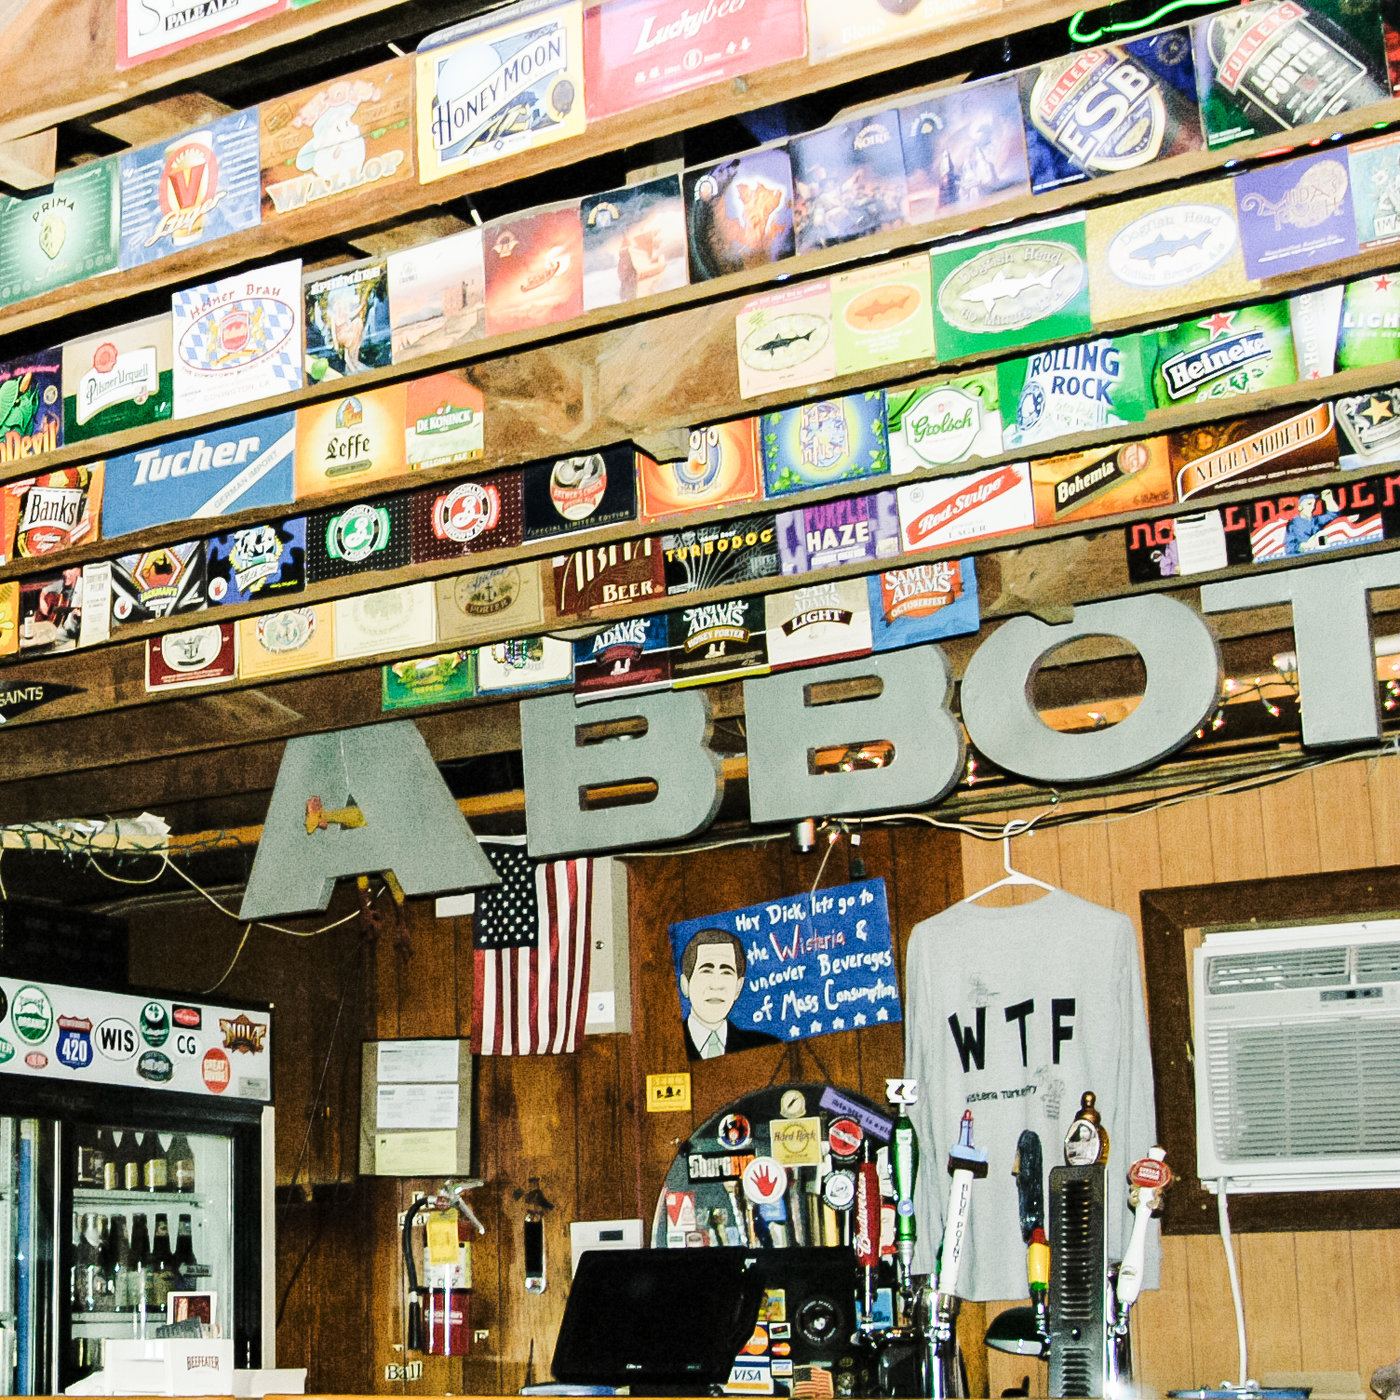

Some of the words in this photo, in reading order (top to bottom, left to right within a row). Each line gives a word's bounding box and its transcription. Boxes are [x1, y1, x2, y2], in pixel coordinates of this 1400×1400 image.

[1251, 31, 1311, 90] LONDON
[1265, 42, 1328, 105] PORTER
[431, 76, 500, 145] HONEY
[504, 38, 563, 92] MOON
[1059, 62, 1151, 161] ESB
[266, 150, 405, 214] WALLOP
[32, 196, 76, 223] PRIMA
[1030, 343, 1120, 379] ROLLING
[1051, 376, 1114, 405] ROCK
[911, 407, 973, 443] Grolsch
[132, 435, 261, 487] Tucher
[325, 433, 371, 461] Leffe
[1196, 444, 1248, 481] NEGRA
[1252, 415, 1315, 461] MODELO
[1056, 460, 1116, 503] Bohemia
[28, 489, 78, 525] Banks
[918, 506, 953, 536] Red
[953, 477, 1005, 515] Stripe
[666, 528, 775, 563] TURBODOG
[806, 521, 870, 552] HAZE
[885, 561, 955, 591] SAMUEL
[892, 574, 952, 605] ADAMS
[603, 581, 653, 604] BEER
[891, 596, 947, 617] OCTOBERFEST
[688, 609, 745, 637] ADAMS
[792, 609, 842, 630] LIGHT
[592, 626, 646, 653] ADAMS
[811, 896, 833, 916] lets
[837, 896, 855, 915] go
[859, 889, 874, 906] to
[747, 941, 769, 966] the
[769, 924, 846, 962] Wisteria
[856, 920, 868, 941] &
[749, 964, 807, 992] uncover
[816, 949, 892, 977] Beverages
[752, 995, 773, 1023] of
[780, 991, 819, 1021] Mass
[61, 1038, 87, 1062] 420
[101, 1027, 134, 1052] WIS
[177, 1035, 196, 1055] CG
[947, 997, 1077, 1074] WTF
[774, 1131, 794, 1142] Hard
[795, 1131, 817, 1141] Rock
[186, 1355, 220, 1372] BEEFEATER
[386, 1362, 422, 1381] Ball
[733, 1370, 762, 1382] VISA
